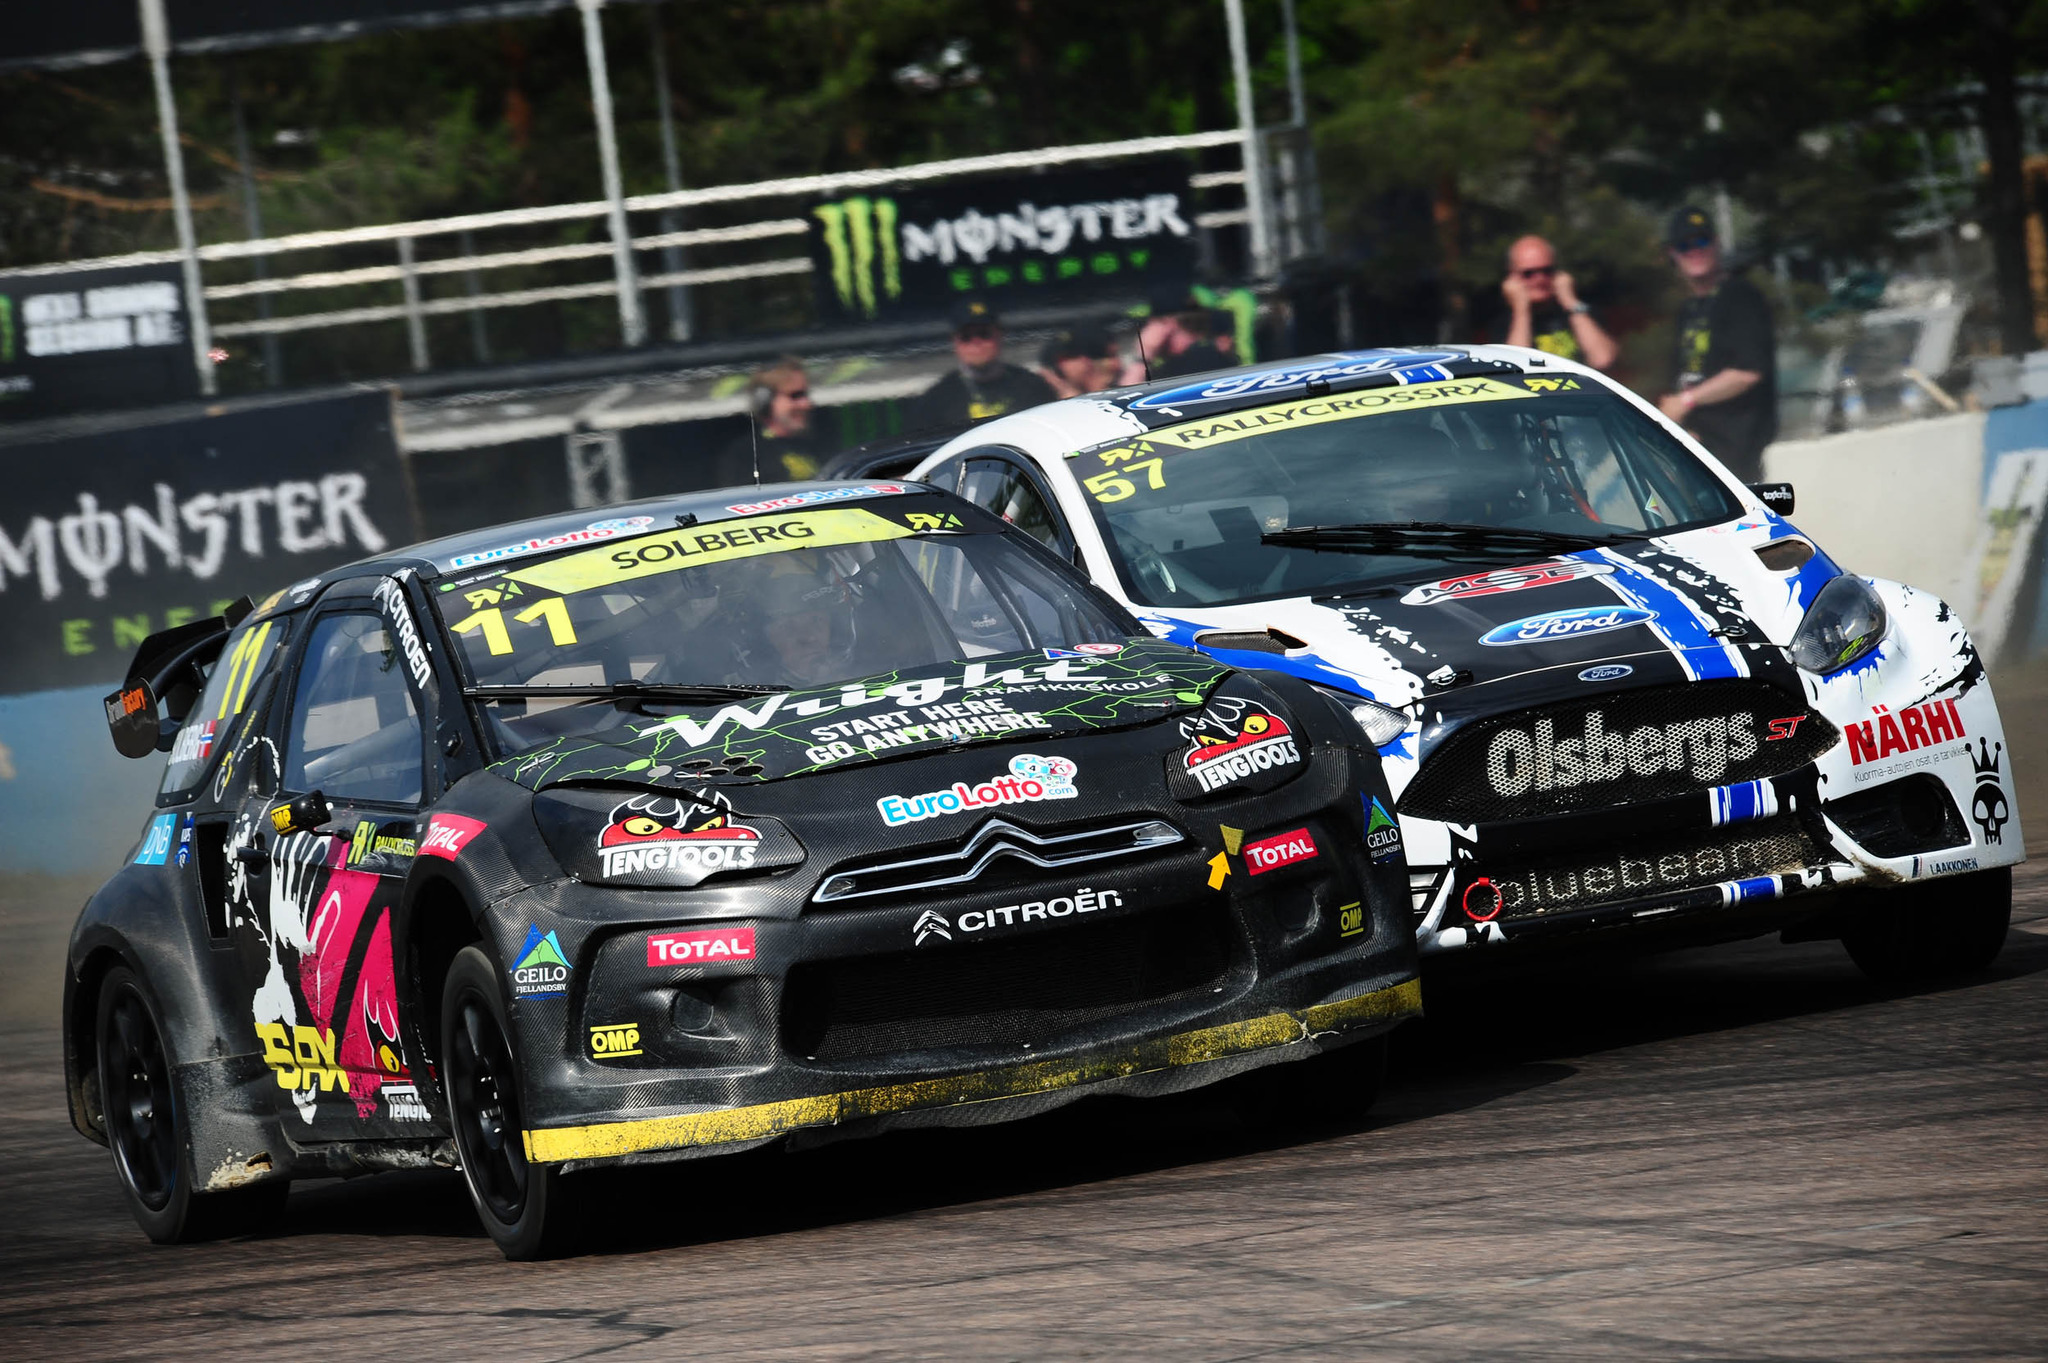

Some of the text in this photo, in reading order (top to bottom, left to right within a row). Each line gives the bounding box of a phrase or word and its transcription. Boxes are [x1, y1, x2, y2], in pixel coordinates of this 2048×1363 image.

[902, 193, 1189, 264] MONSTER
[1201, 359, 1399, 397] Ford
[1177, 380, 1501, 444] RALLYCROSSRX
[1083, 457, 1167, 503] 57
[0, 472, 387, 600] MONSTER
[455, 529, 613, 567] EuroLotto
[611, 521, 815, 570] SOLBERG
[450, 596, 577, 656] 11
[1517, 611, 1623, 640] Ford
[217, 621, 273, 720] 11
[966, 673, 1175, 697] TRAFIKKSKOLE
[805, 711, 1053, 765] GO ANYWHERE
[810, 698, 1014, 742] START HERE
[1766, 715, 1806, 741] ST
[1844, 697, 1966, 766] NÄRHI
[1486, 710, 1758, 797] Olsbergs
[884, 778, 1043, 824] EuroLotto
[1247, 839, 1314, 867] TOTAL
[1367, 828, 1398, 848] GEILO
[1930, 858, 1978, 875] LAAKKONEN
[958, 889, 1122, 932] CITROËN
[1340, 908, 1363, 931] OMP
[652, 938, 750, 961] TOTAL
[515, 966, 567, 984] GEILO
[516, 983, 567, 994] FJELLANDSBY
[591, 1029, 640, 1053] OMP
